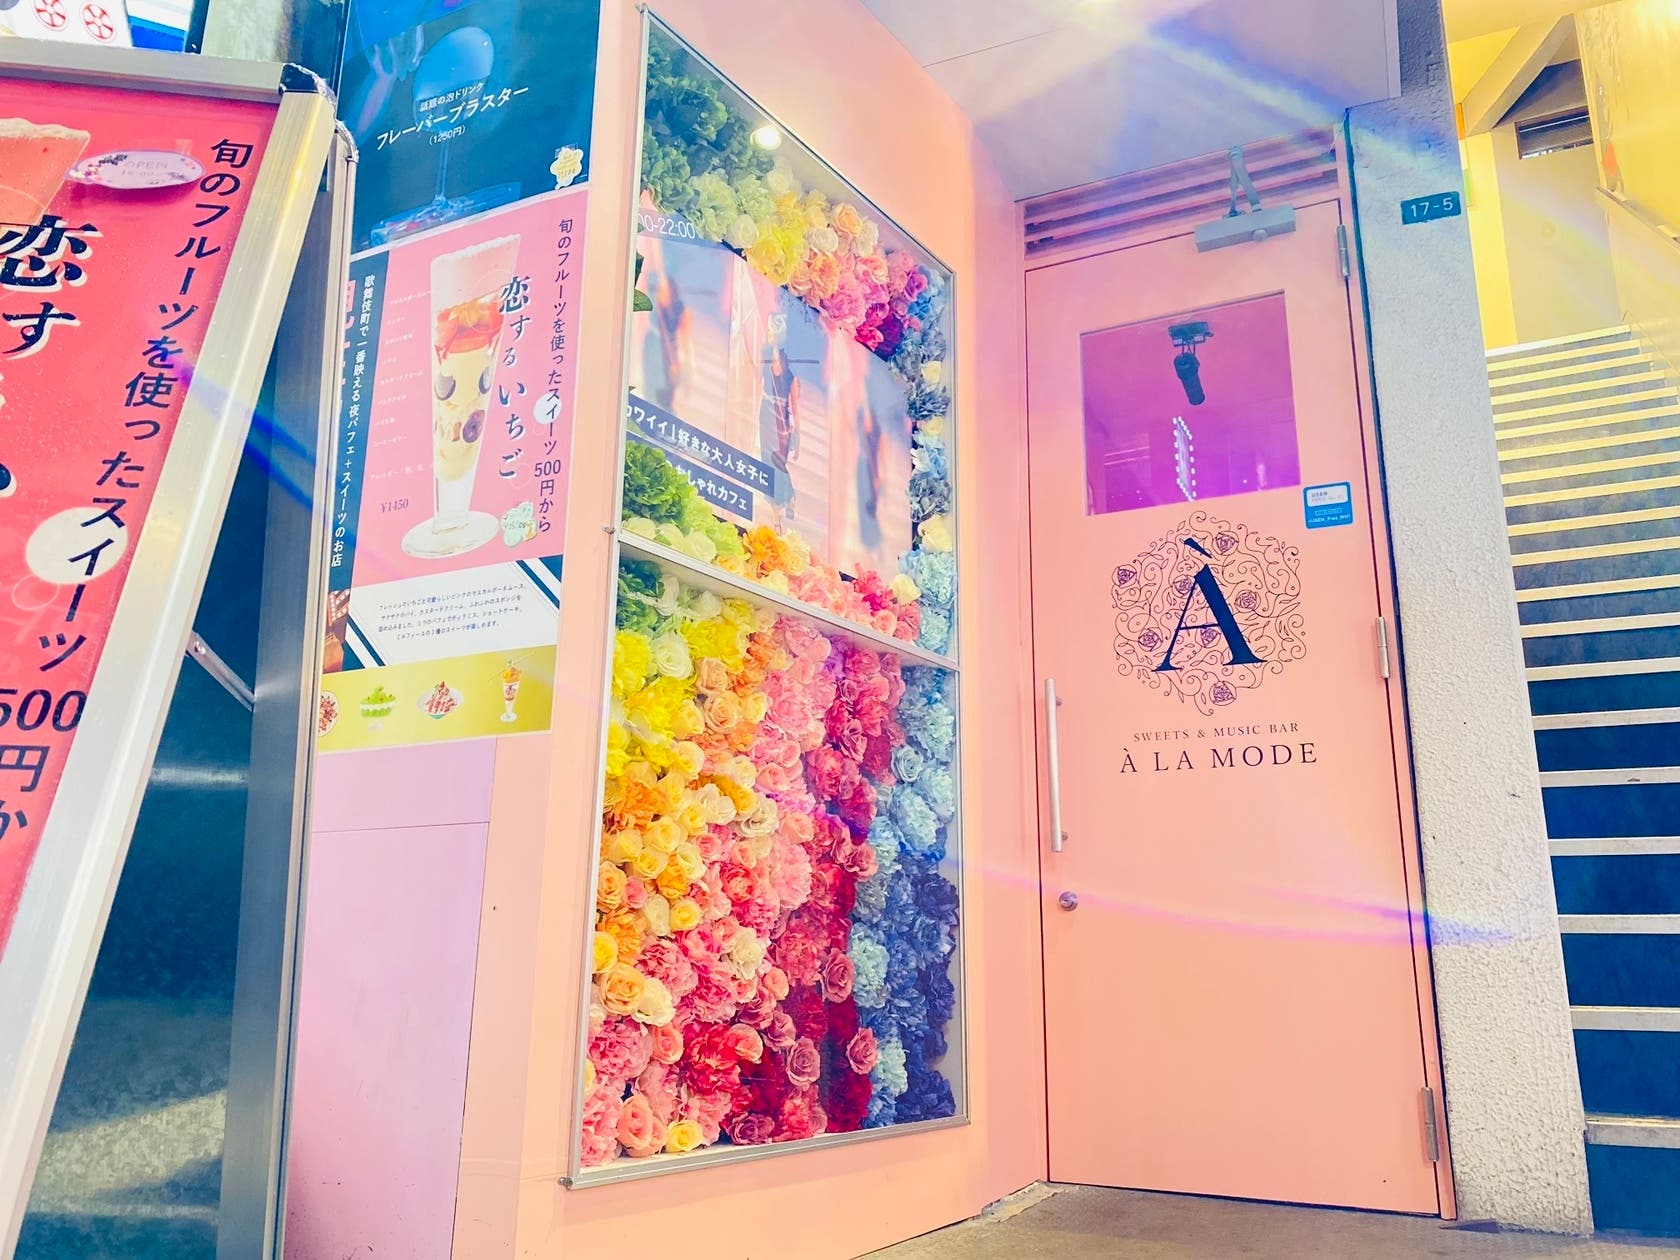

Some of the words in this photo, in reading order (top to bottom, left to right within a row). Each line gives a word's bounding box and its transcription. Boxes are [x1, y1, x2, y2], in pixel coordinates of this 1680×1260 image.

[377, 87, 529, 150] フレーバーブラスター
[1410, 198, 1453, 218] 17-5
[1133, 729, 1190, 742] SWEETS
[1196, 728, 1207, 739] &
[1213, 724, 1261, 737] MUSIC
[1268, 721, 1300, 734] BAR
[1119, 747, 1138, 773] À
[1153, 750, 1194, 771] LA
[1210, 742, 1318, 769] MODE
